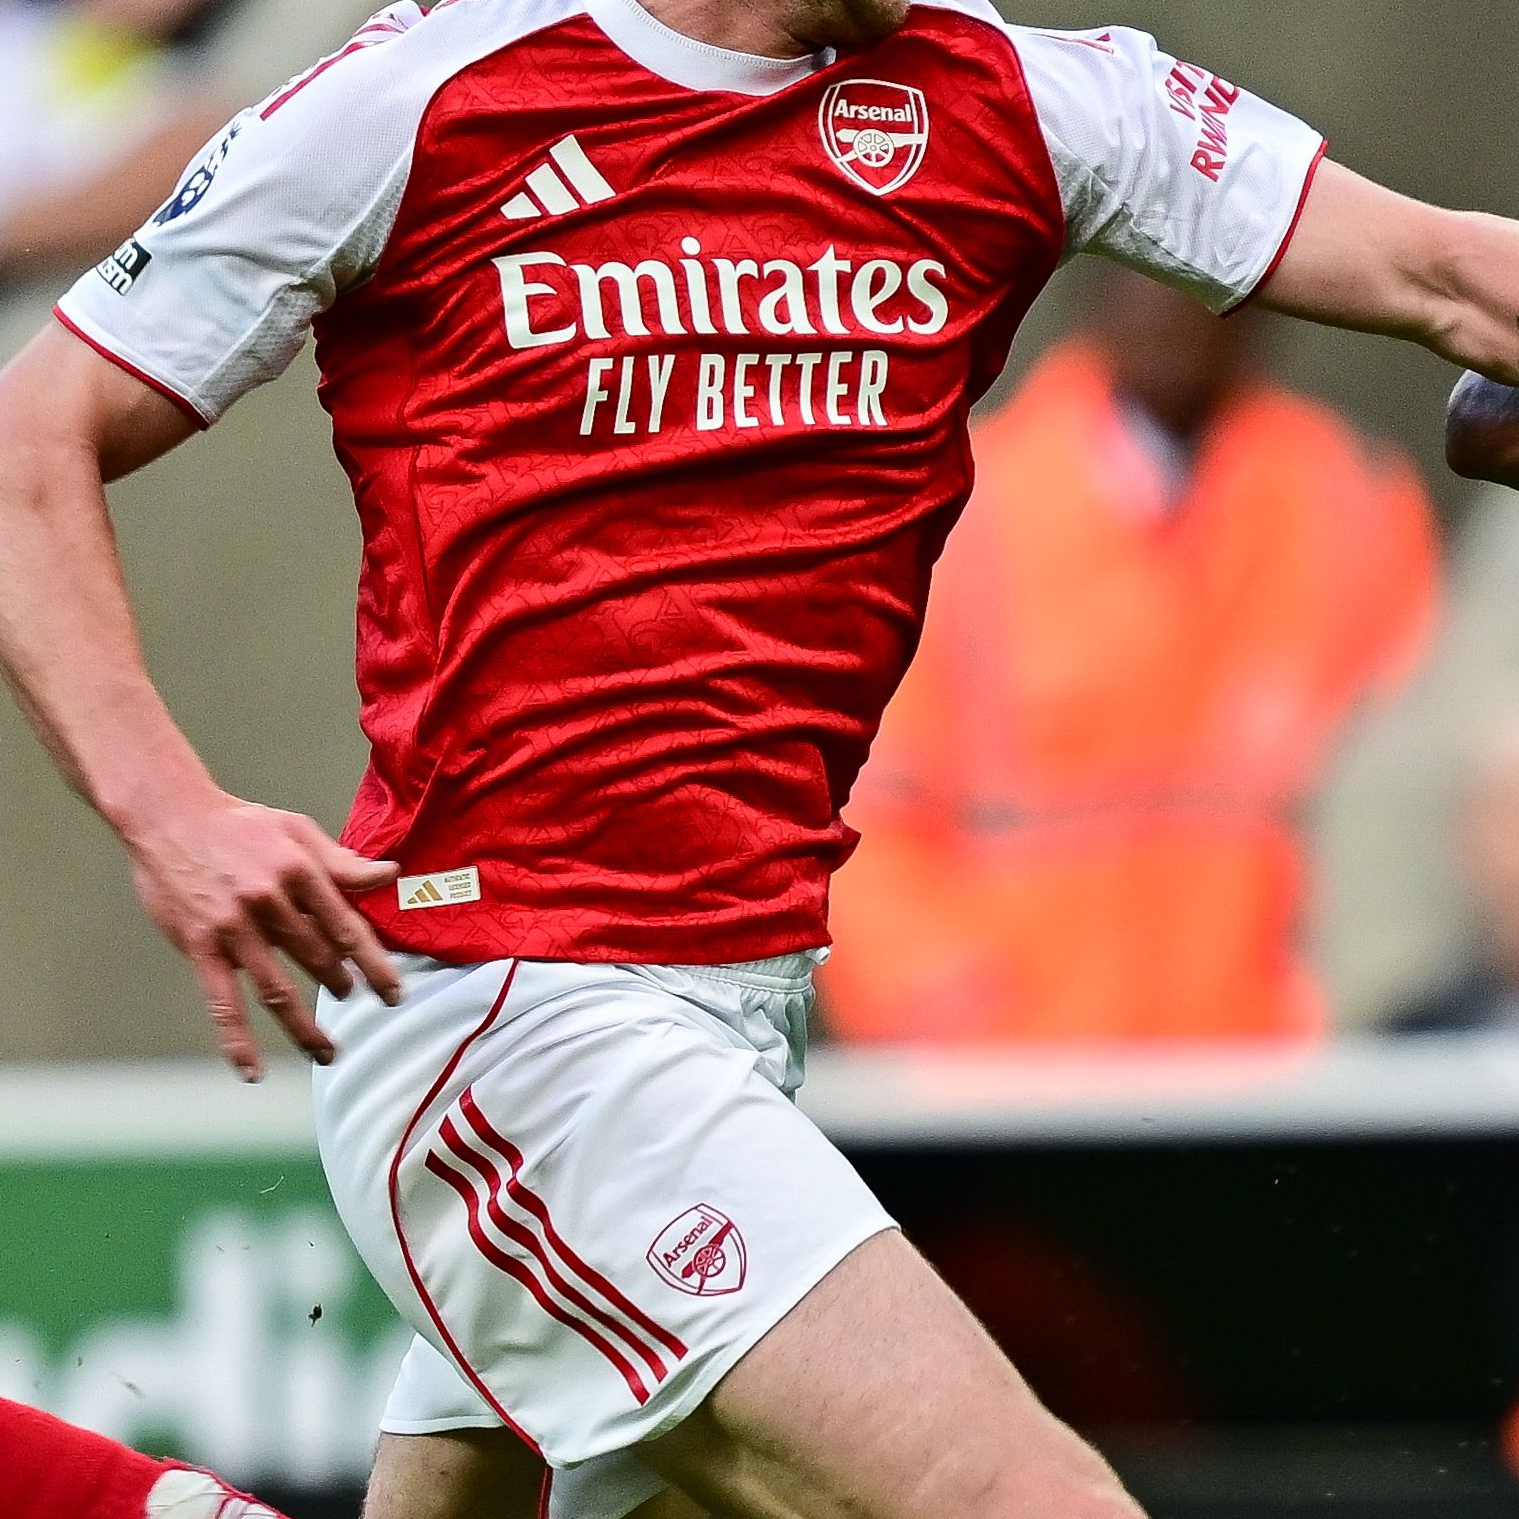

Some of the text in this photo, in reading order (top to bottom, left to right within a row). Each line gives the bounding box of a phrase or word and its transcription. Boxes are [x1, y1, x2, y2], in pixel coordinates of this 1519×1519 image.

[834, 99, 913, 122] Arsenal
[1190, 75, 1241, 182] RWAND
[490, 235, 949, 349] Emirates
[579, 349, 889, 435] FLY BETTER
[662, 1215, 713, 1268] Arsenal
